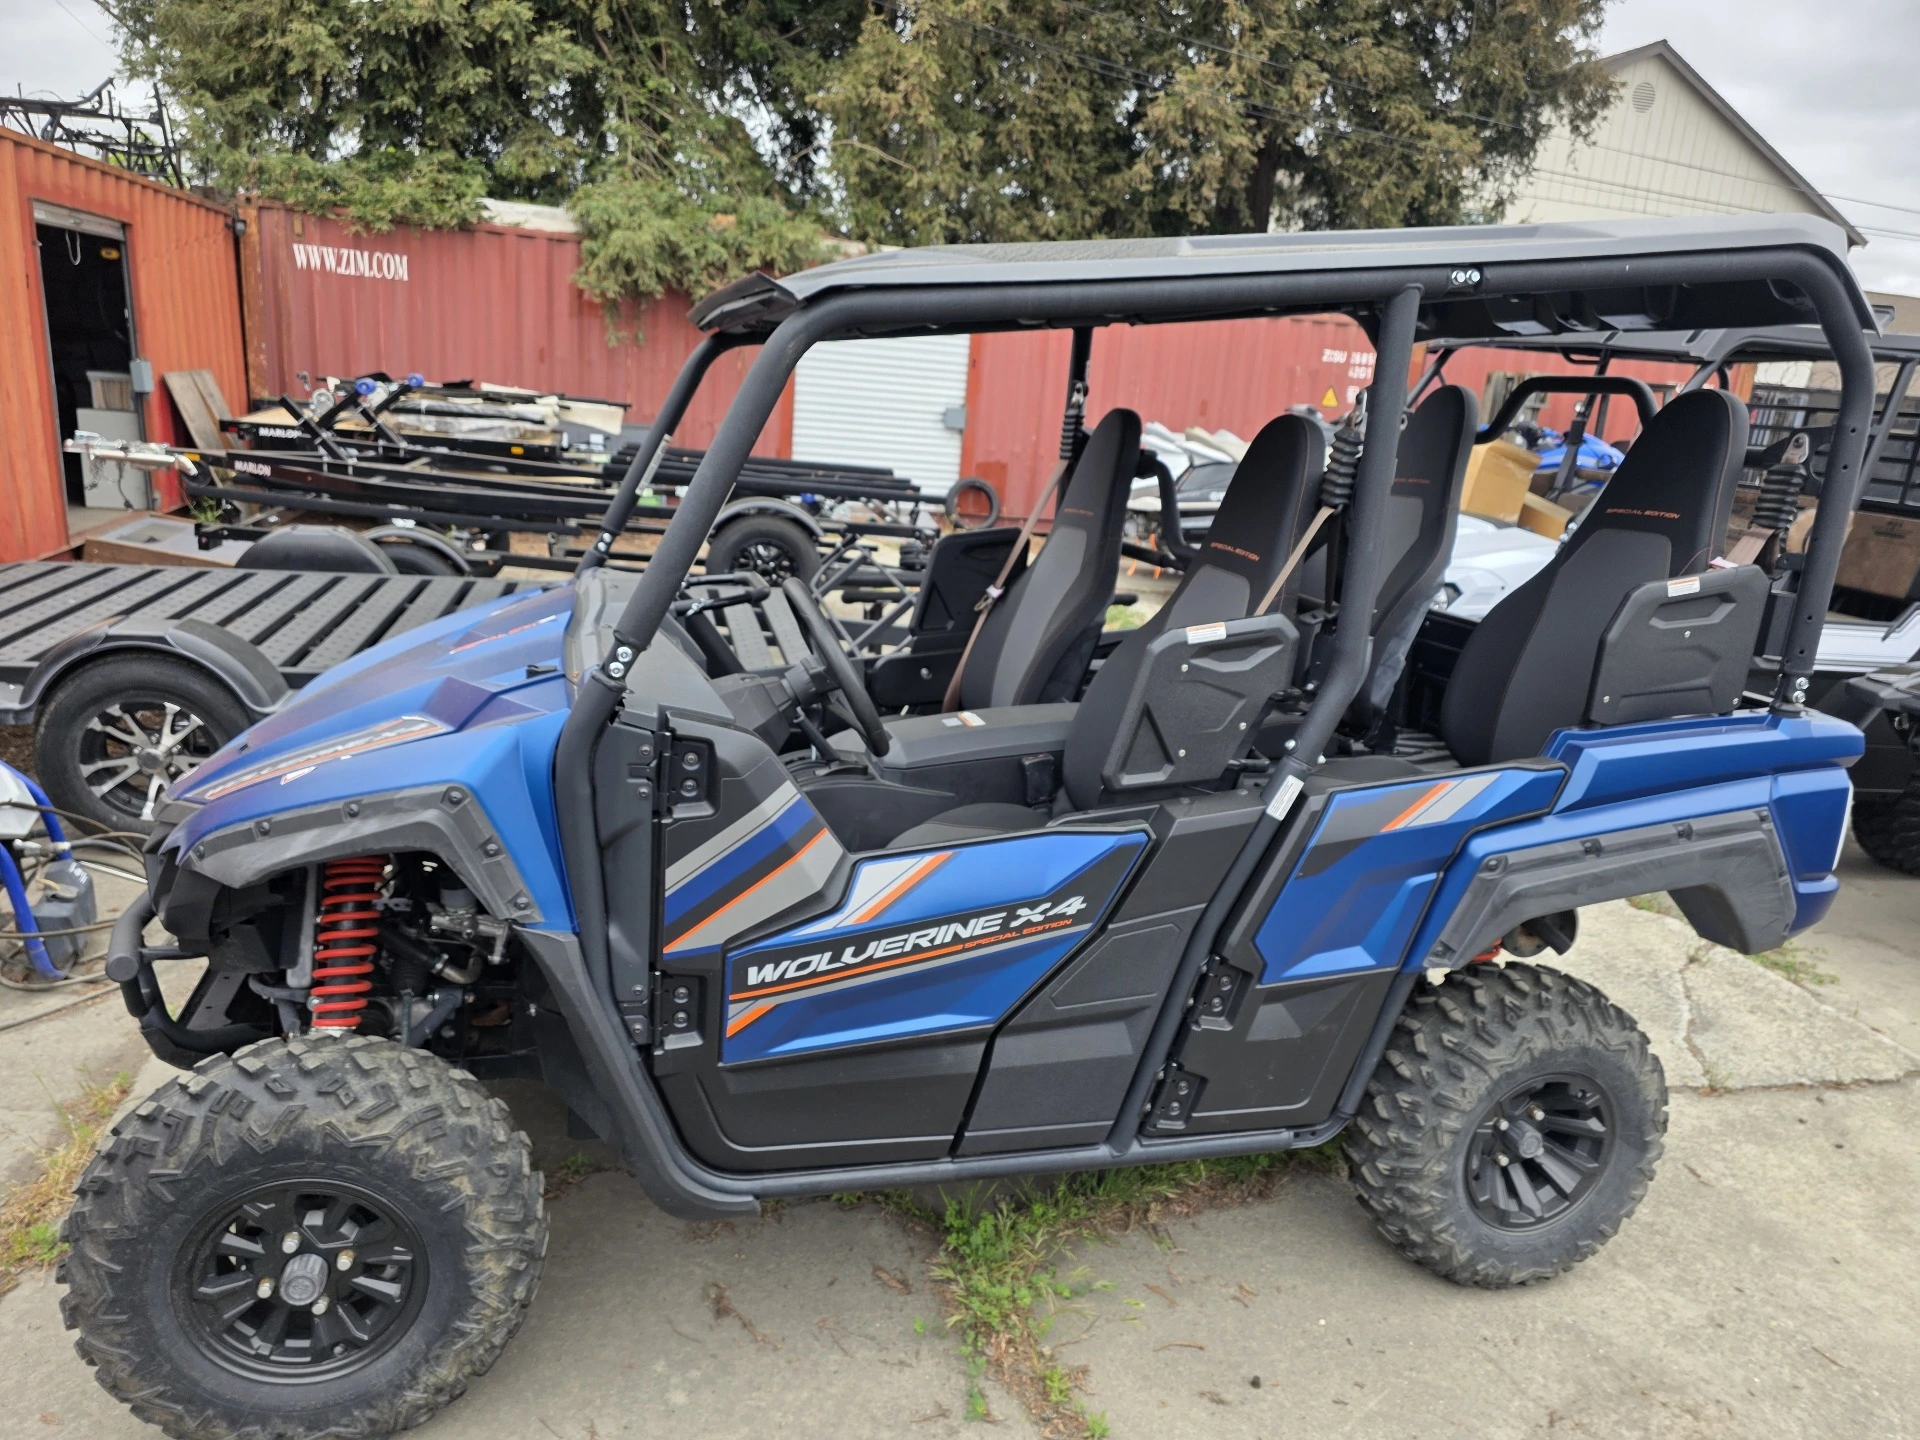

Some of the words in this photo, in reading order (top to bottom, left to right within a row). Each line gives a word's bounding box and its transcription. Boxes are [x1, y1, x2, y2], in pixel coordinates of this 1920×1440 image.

[292, 243, 408, 281] WWW.ZIM.COM
[258, 427, 302, 439] MARLON
[234, 460, 271, 477] MARLON
[747, 911, 1007, 986] WOLVERINE
[1009, 895, 1087, 928] X4
[962, 931, 1021, 949] SPECIAL
[1022, 918, 1073, 935] EDITION
